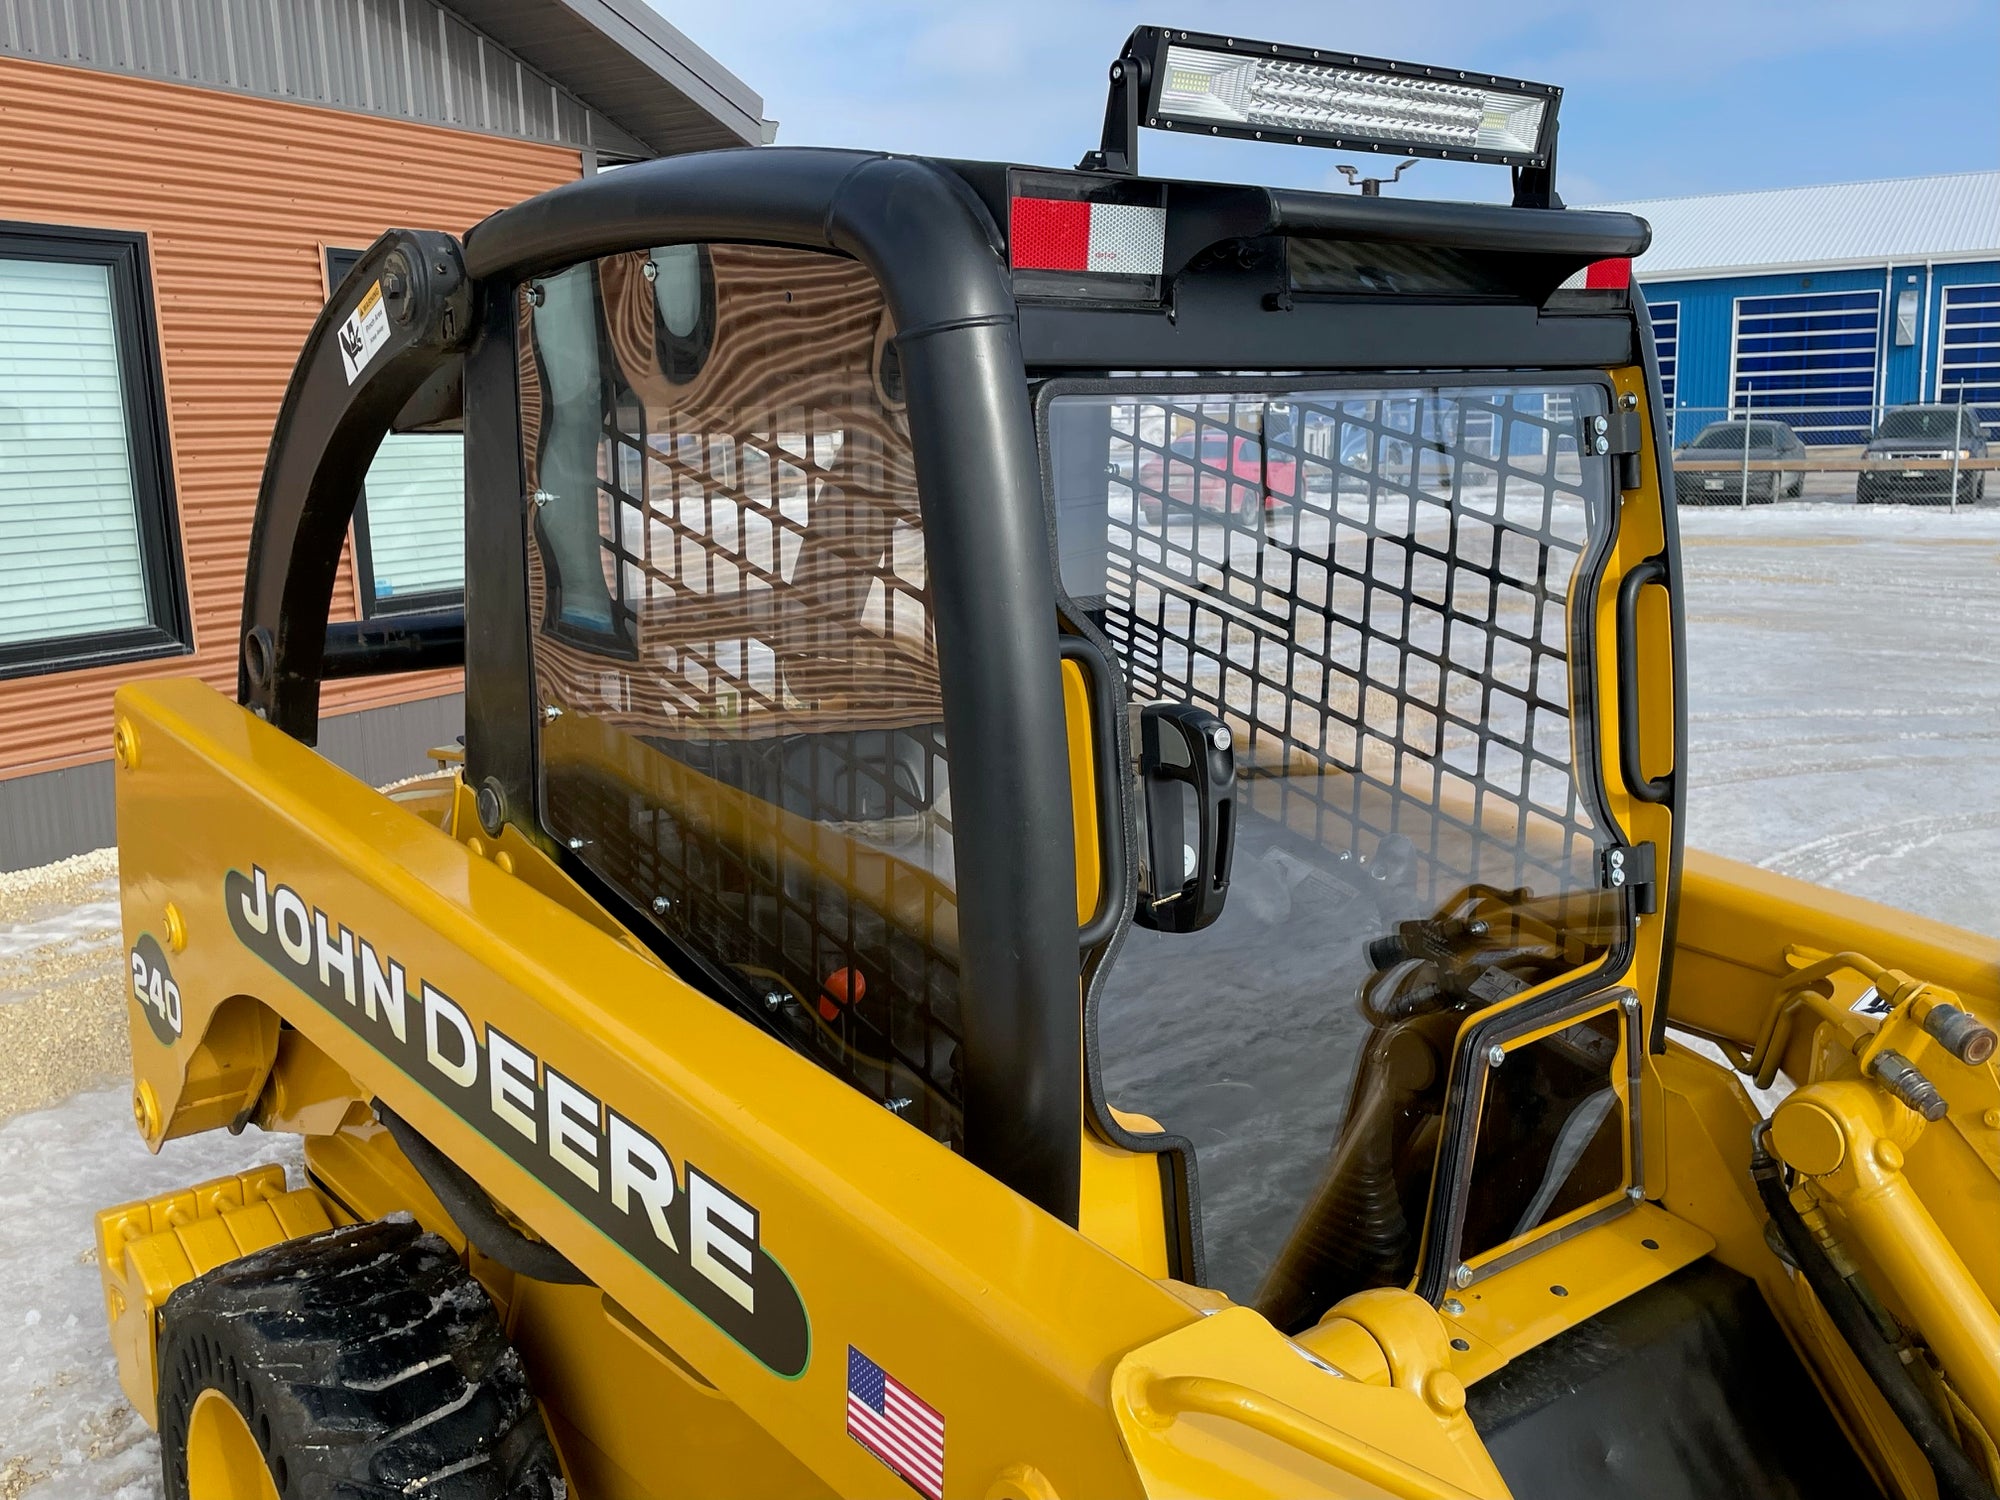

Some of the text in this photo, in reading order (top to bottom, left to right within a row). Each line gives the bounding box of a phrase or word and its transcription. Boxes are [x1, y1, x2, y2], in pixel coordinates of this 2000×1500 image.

[363, 287, 380, 311] WARNING
[374, 310, 383, 320] Area
[131, 951, 183, 1034] 240
[241, 867, 756, 1315] JOHN DEERE
